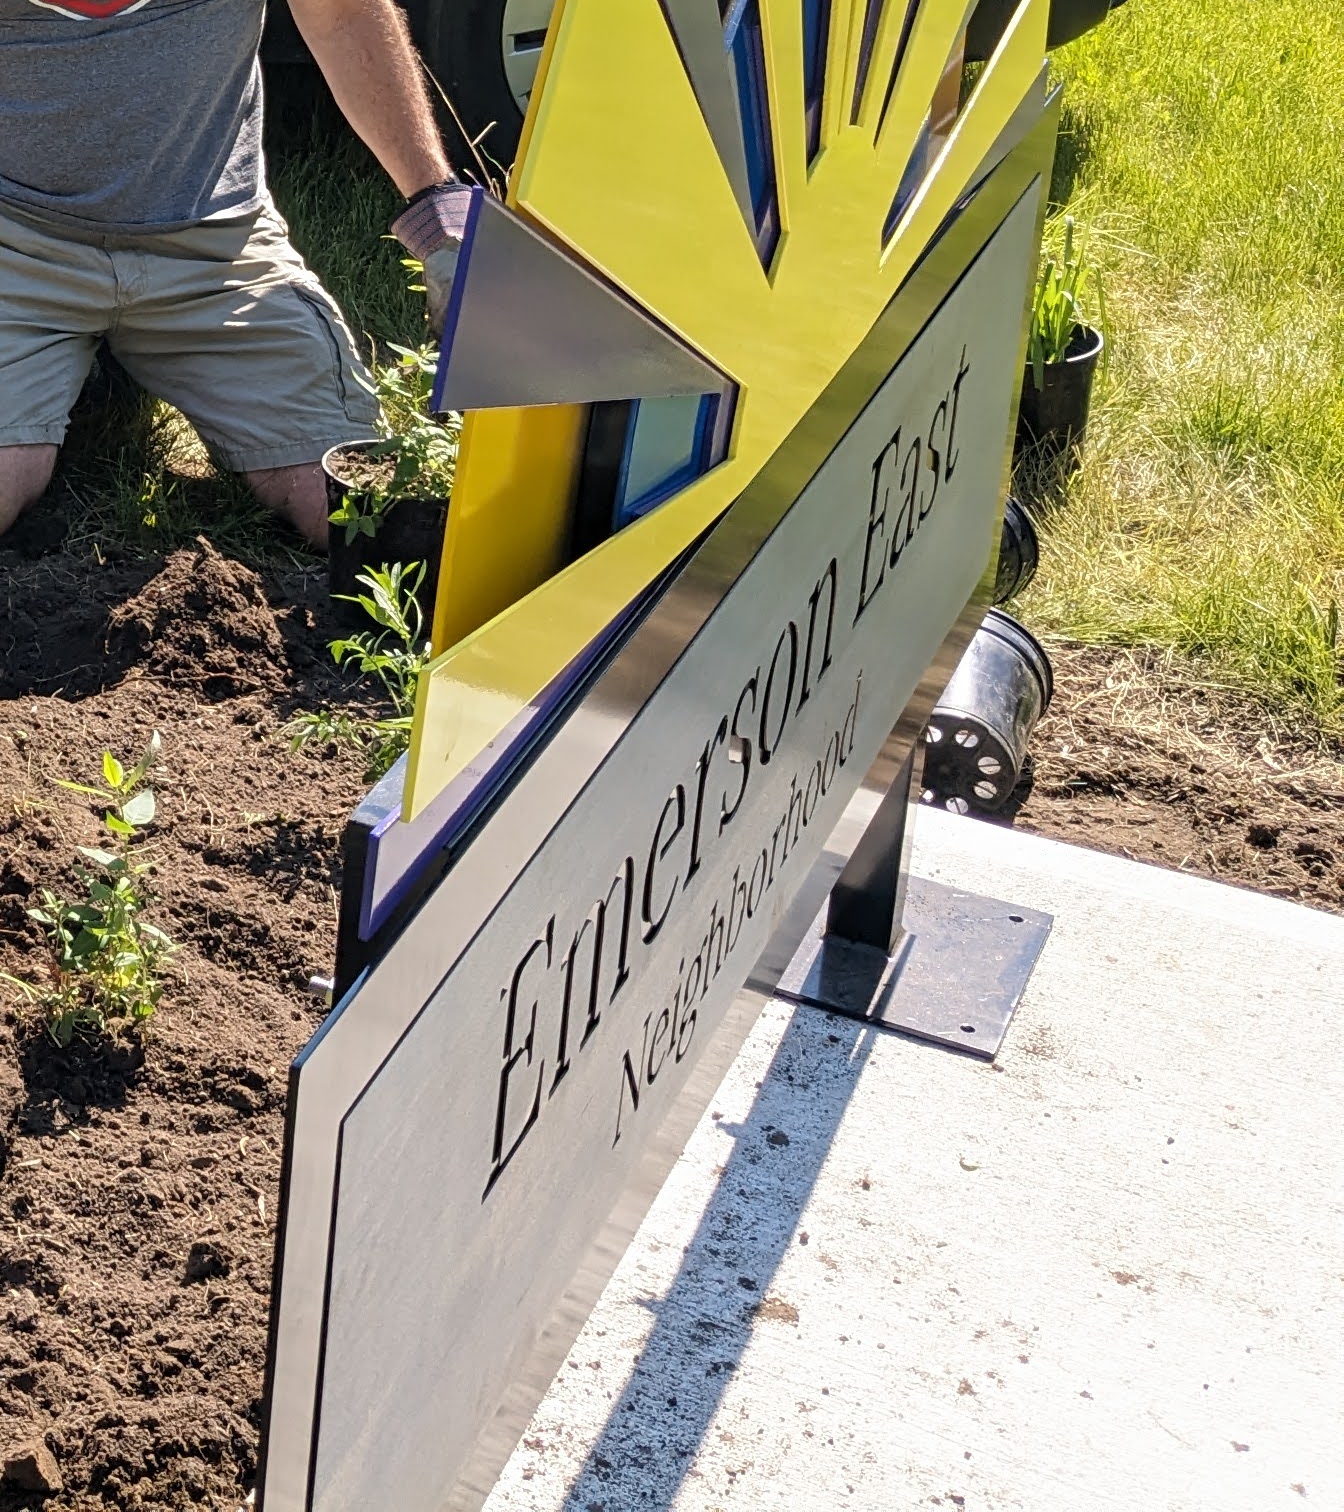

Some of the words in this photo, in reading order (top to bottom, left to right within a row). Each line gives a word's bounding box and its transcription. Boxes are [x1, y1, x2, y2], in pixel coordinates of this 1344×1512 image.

[482, 557, 838, 1203] Emerson
[852, 344, 970, 629] East
[611, 668, 863, 1150] Neighborhood
